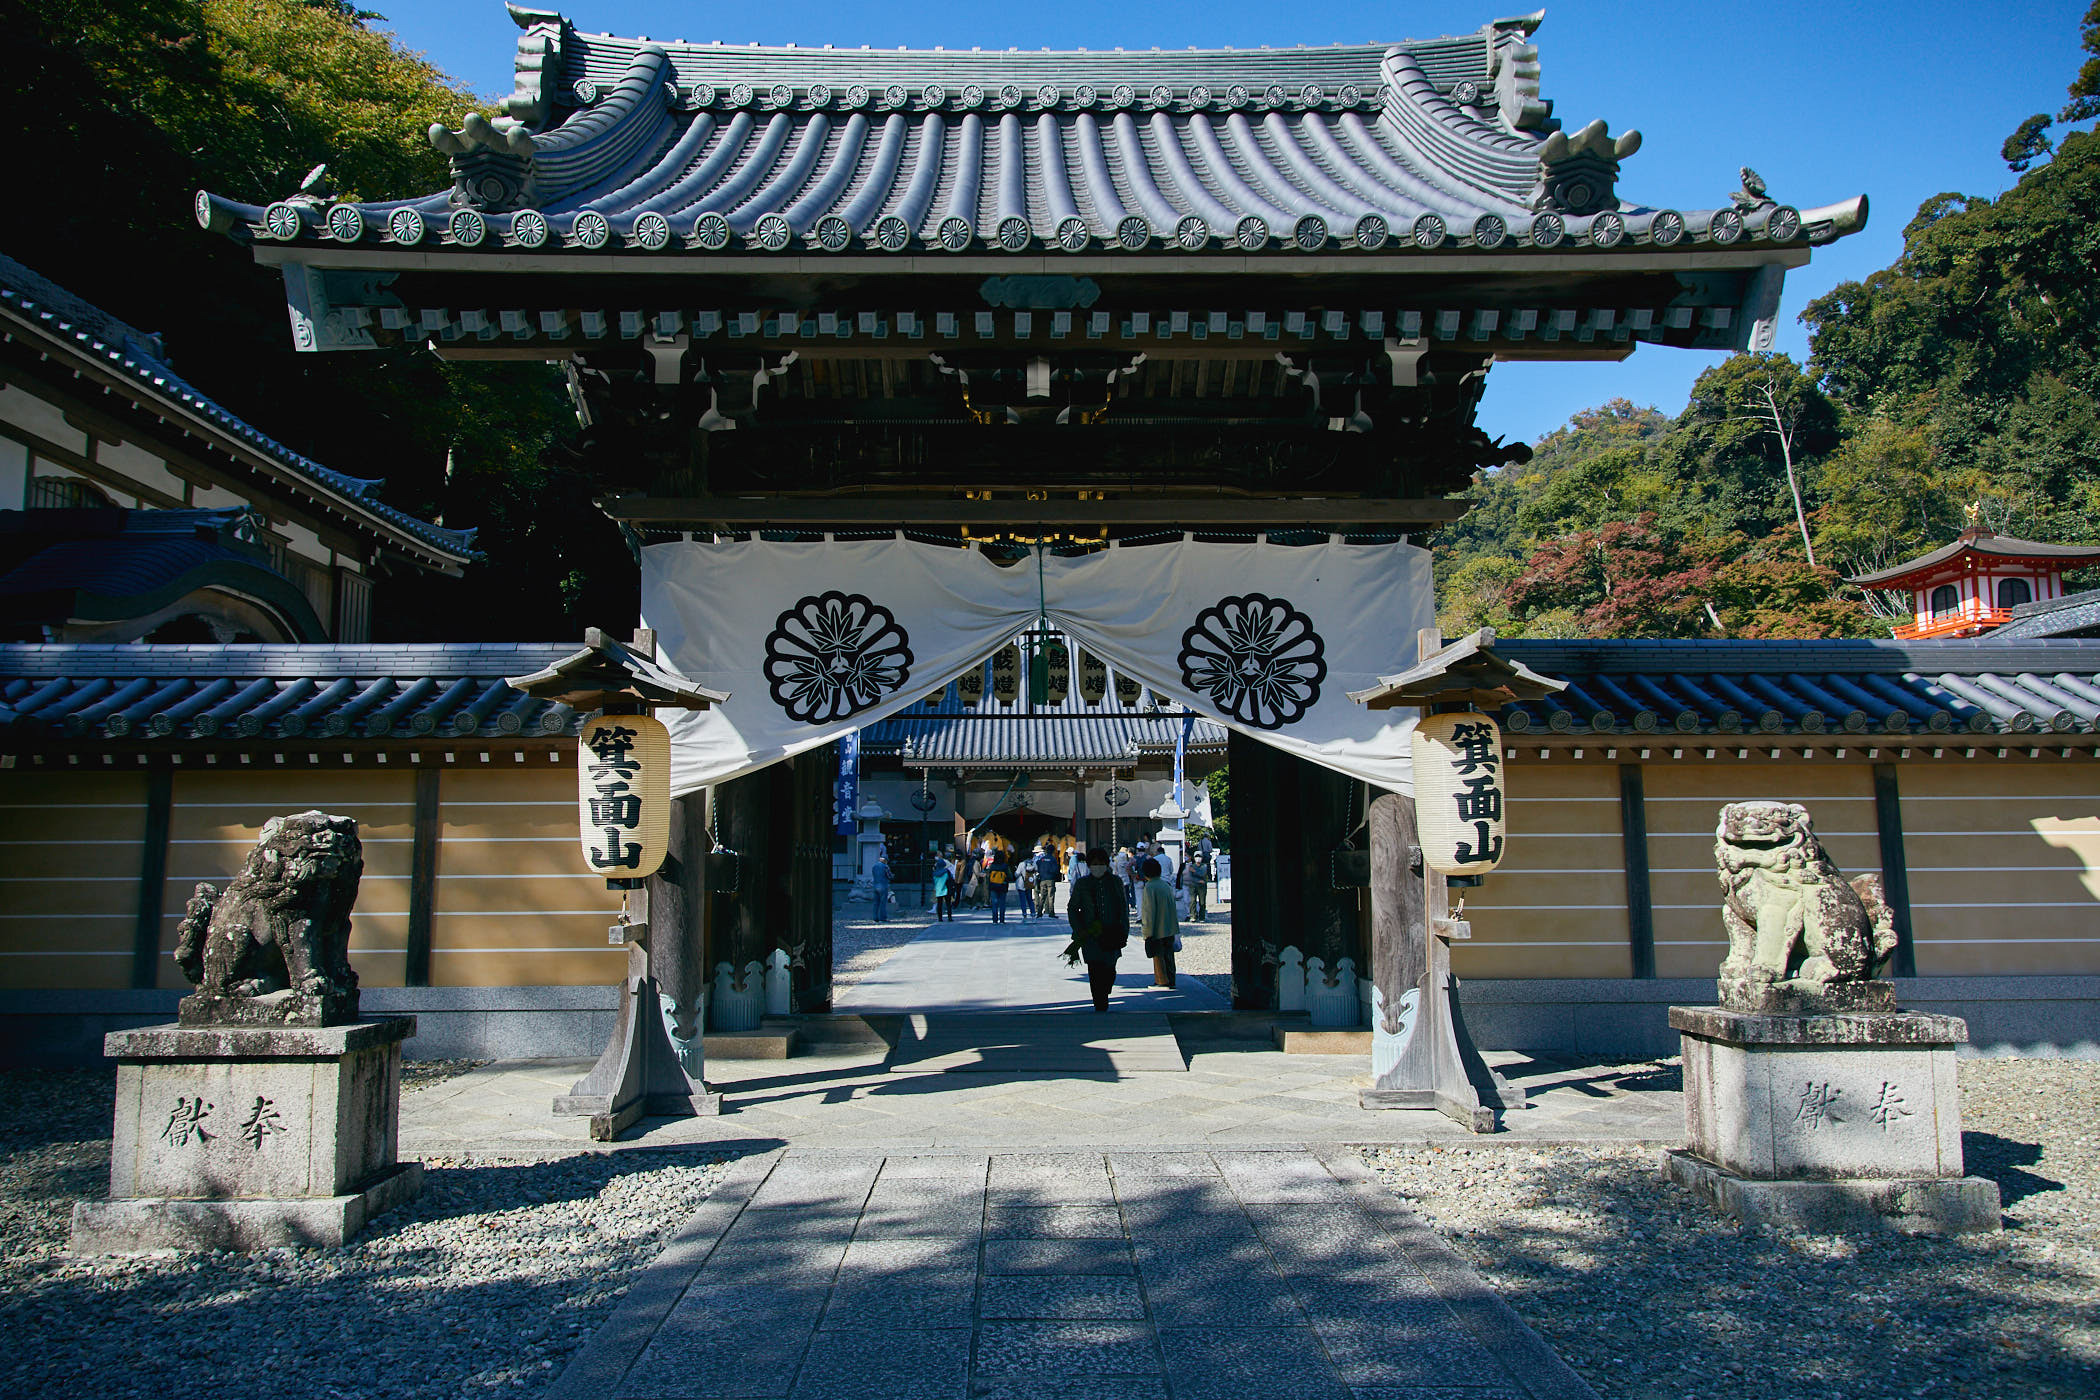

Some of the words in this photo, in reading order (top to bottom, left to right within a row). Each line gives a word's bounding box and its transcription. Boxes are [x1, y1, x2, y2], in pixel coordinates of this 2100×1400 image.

[588, 726, 643, 869] 箕面山
[1451, 722, 1502, 864] 箕面山
